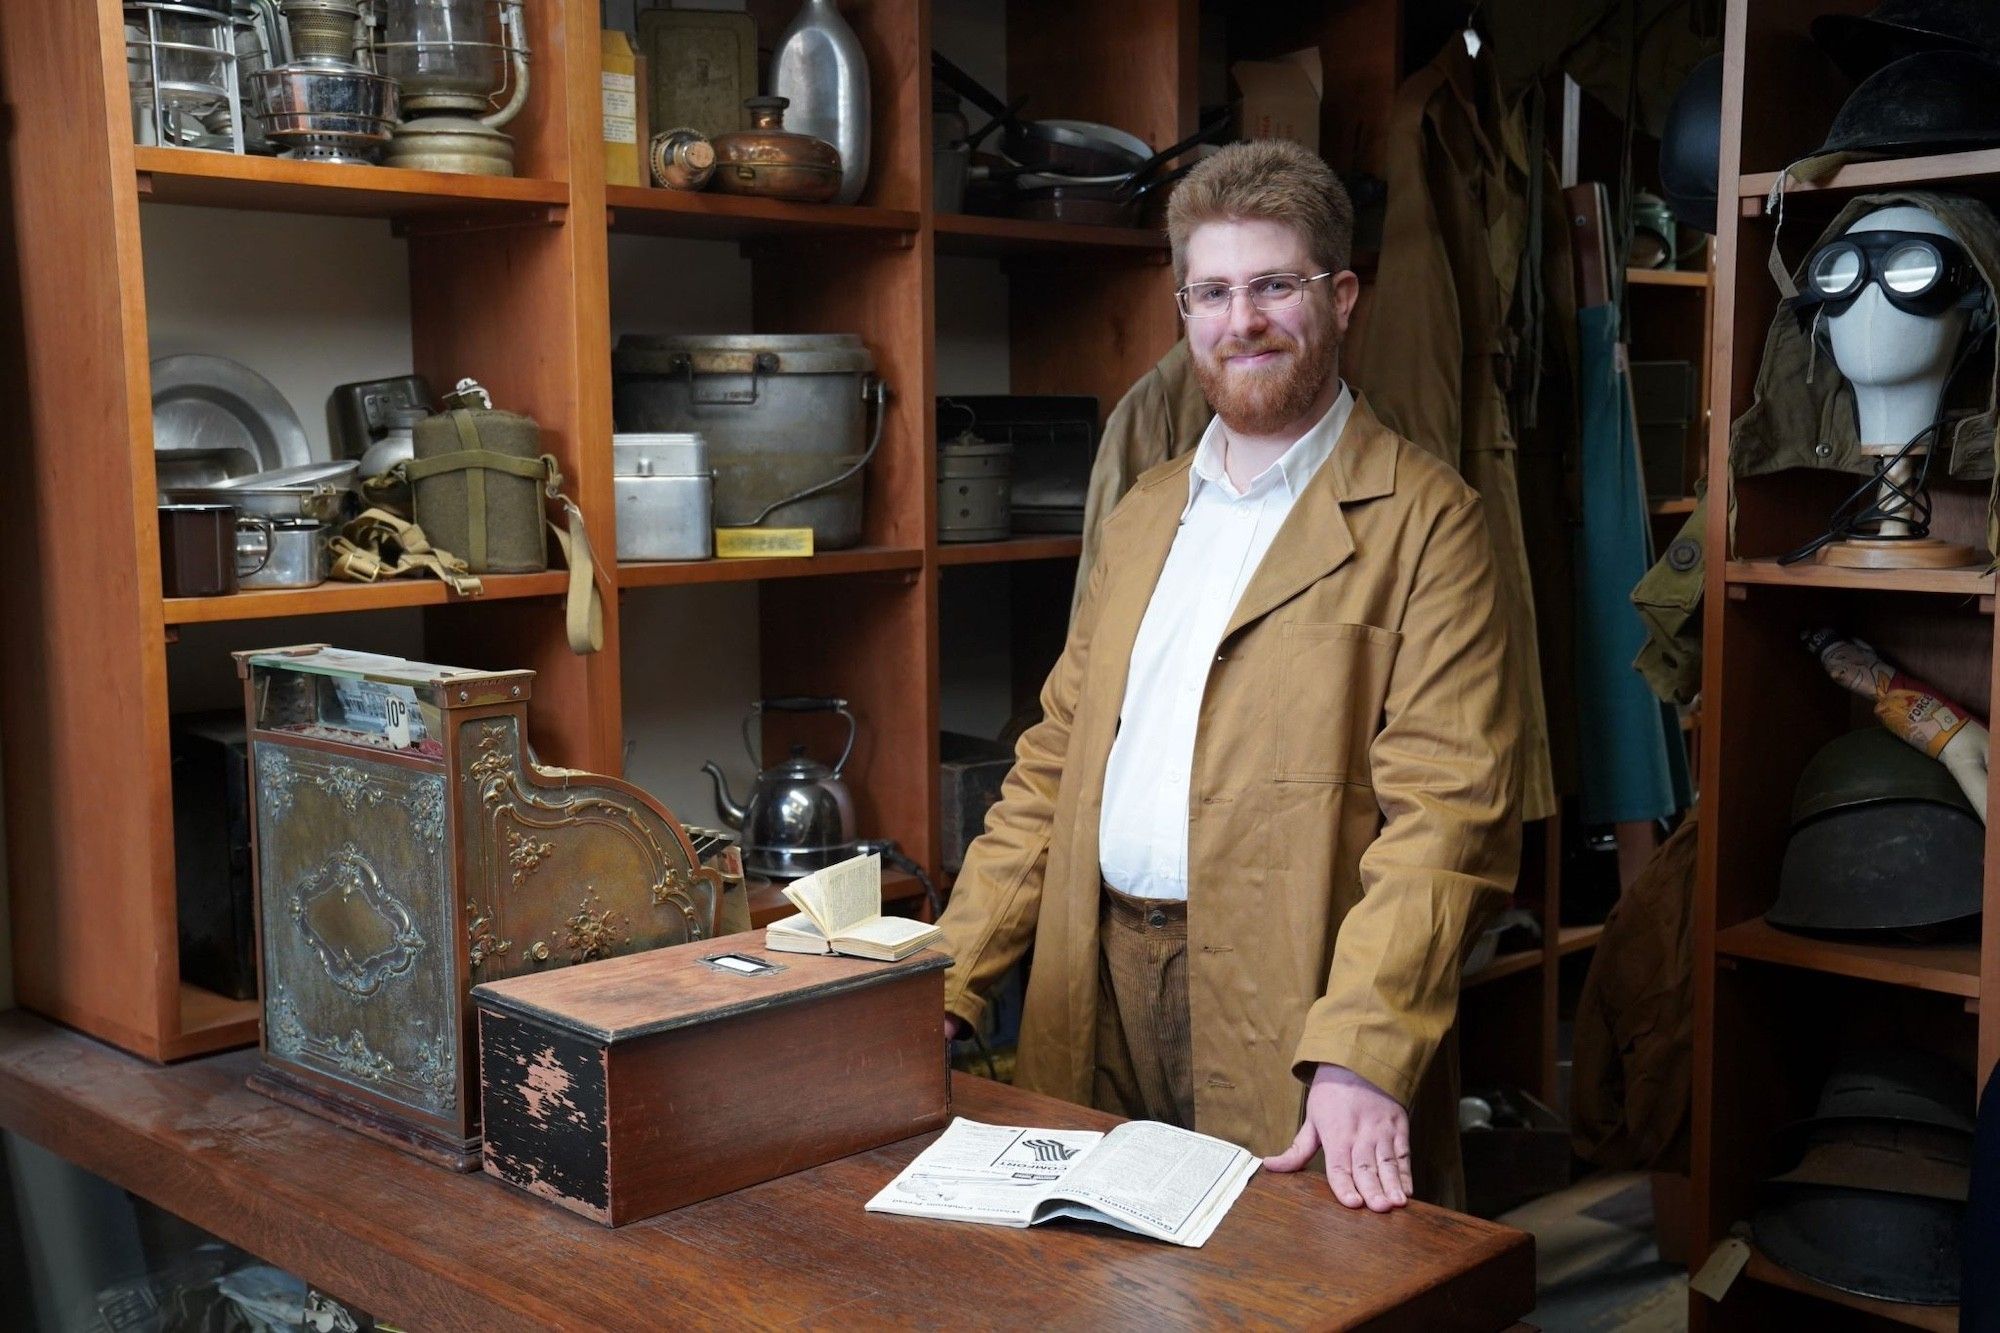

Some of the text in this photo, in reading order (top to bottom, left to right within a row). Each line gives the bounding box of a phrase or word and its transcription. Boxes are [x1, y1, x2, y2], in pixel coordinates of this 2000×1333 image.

[1908, 694, 1934, 722] FORCE
[1000, 1161, 1067, 1170] COMFORT
[1098, 1196, 1174, 1231] Government
